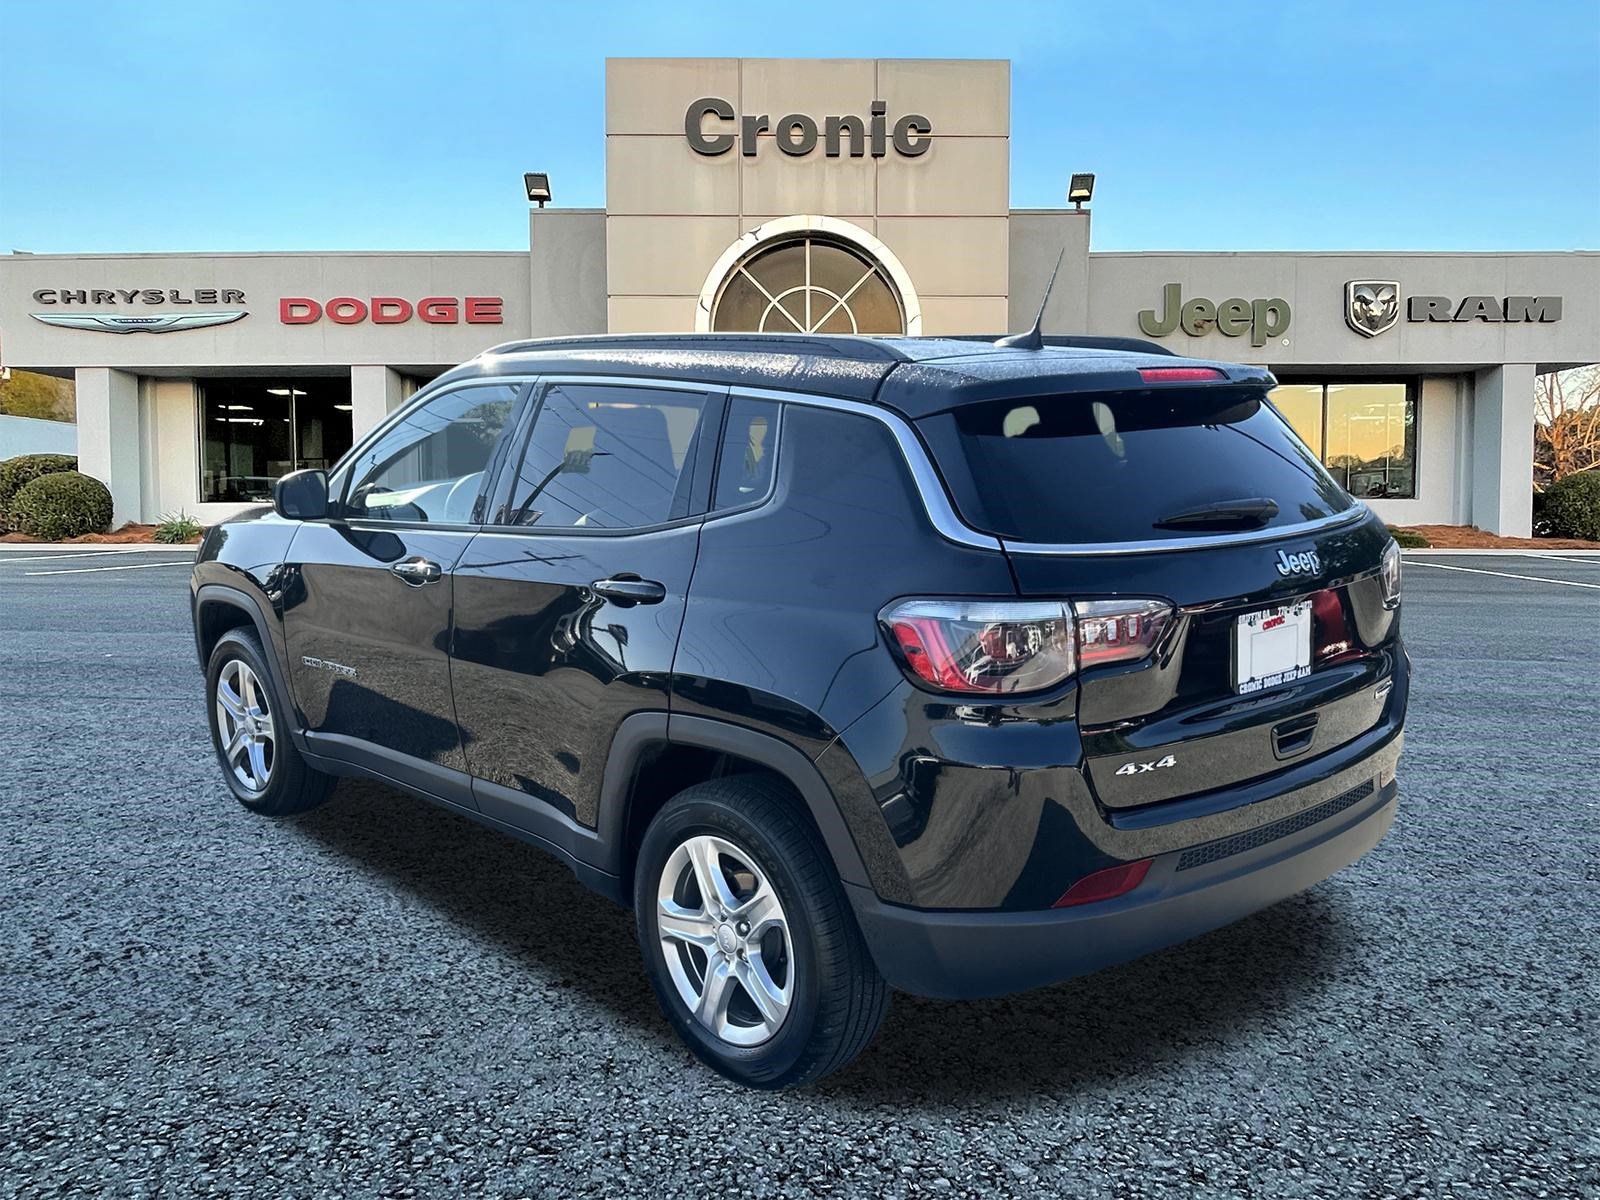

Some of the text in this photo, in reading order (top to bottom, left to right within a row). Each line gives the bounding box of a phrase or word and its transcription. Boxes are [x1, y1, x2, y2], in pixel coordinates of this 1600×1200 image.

[685, 97, 932, 157] Cronic
[32, 289, 247, 304] CHRYSLER
[1407, 296, 1563, 322] RAM
[280, 297, 504, 325] DODGE
[1138, 283, 1292, 347] Jeep
[1276, 550, 1320, 576] Jeep
[1115, 755, 1177, 776] 4x4
